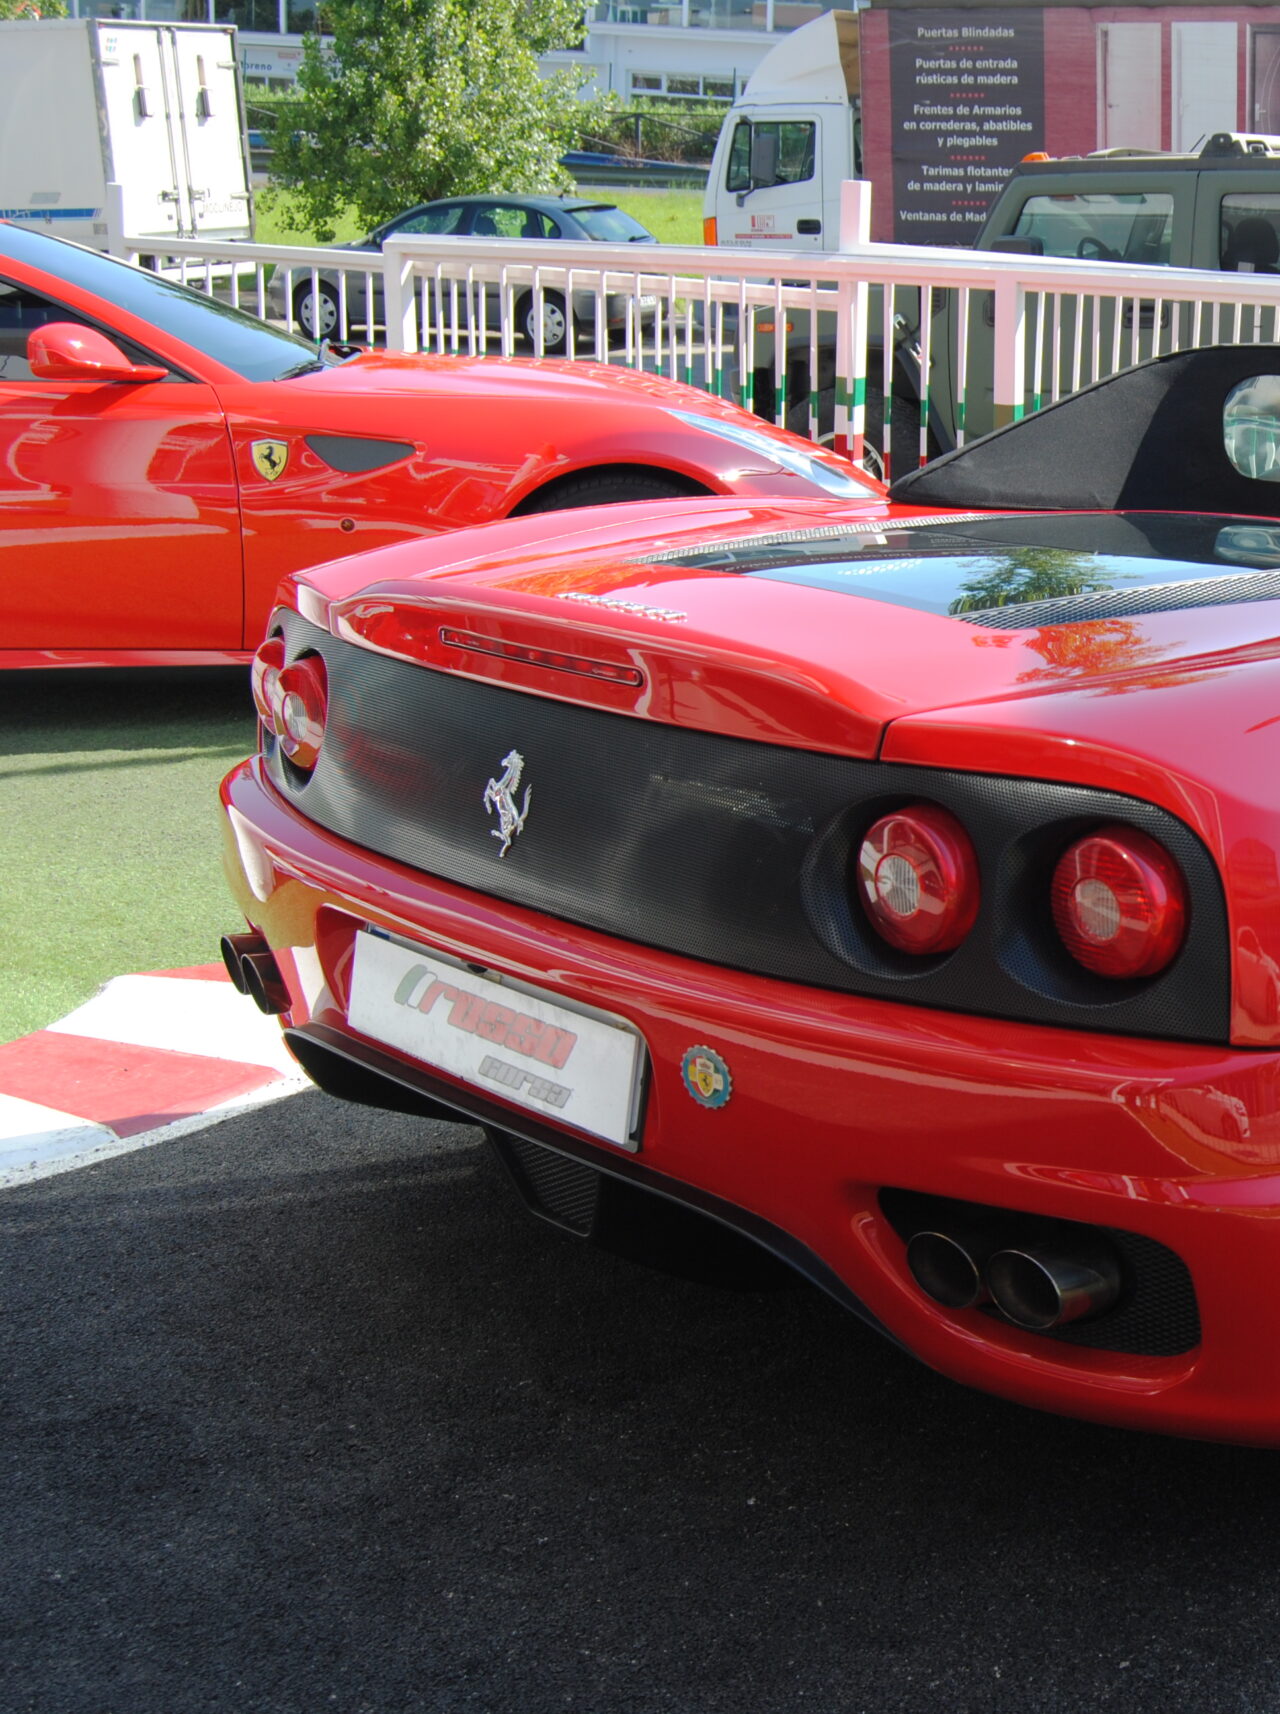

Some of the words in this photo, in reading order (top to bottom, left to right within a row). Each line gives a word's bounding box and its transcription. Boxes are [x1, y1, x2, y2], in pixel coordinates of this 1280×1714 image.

[917, 26, 959, 38] Puertas
[961, 26, 1015, 38] Blindadas
[915, 57, 957, 69] Puertas
[959, 57, 973, 69] de
[975, 57, 1018, 69] entrada
[915, 72, 959, 85] rústicas
[960, 73, 975, 85] de
[977, 74, 1019, 85] madera
[913, 104, 954, 116] Frentes
[956, 104, 970, 116] de
[972, 104, 1022, 116] Armarios
[903, 121, 917, 131] en
[919, 119, 980, 133] correderas,
[982, 119, 1033, 131] abatibles
[937, 137, 944, 148] y
[946, 135, 999, 147] plegables
[921, 165, 965, 177] Tarimas
[907, 180, 921, 191] de
[923, 180, 964, 192] madera
[965, 183, 973, 194] y
[899, 210, 948, 222] Ventanas
[949, 211, 963, 222] de
[478, 1054, 572, 1109] corsa
